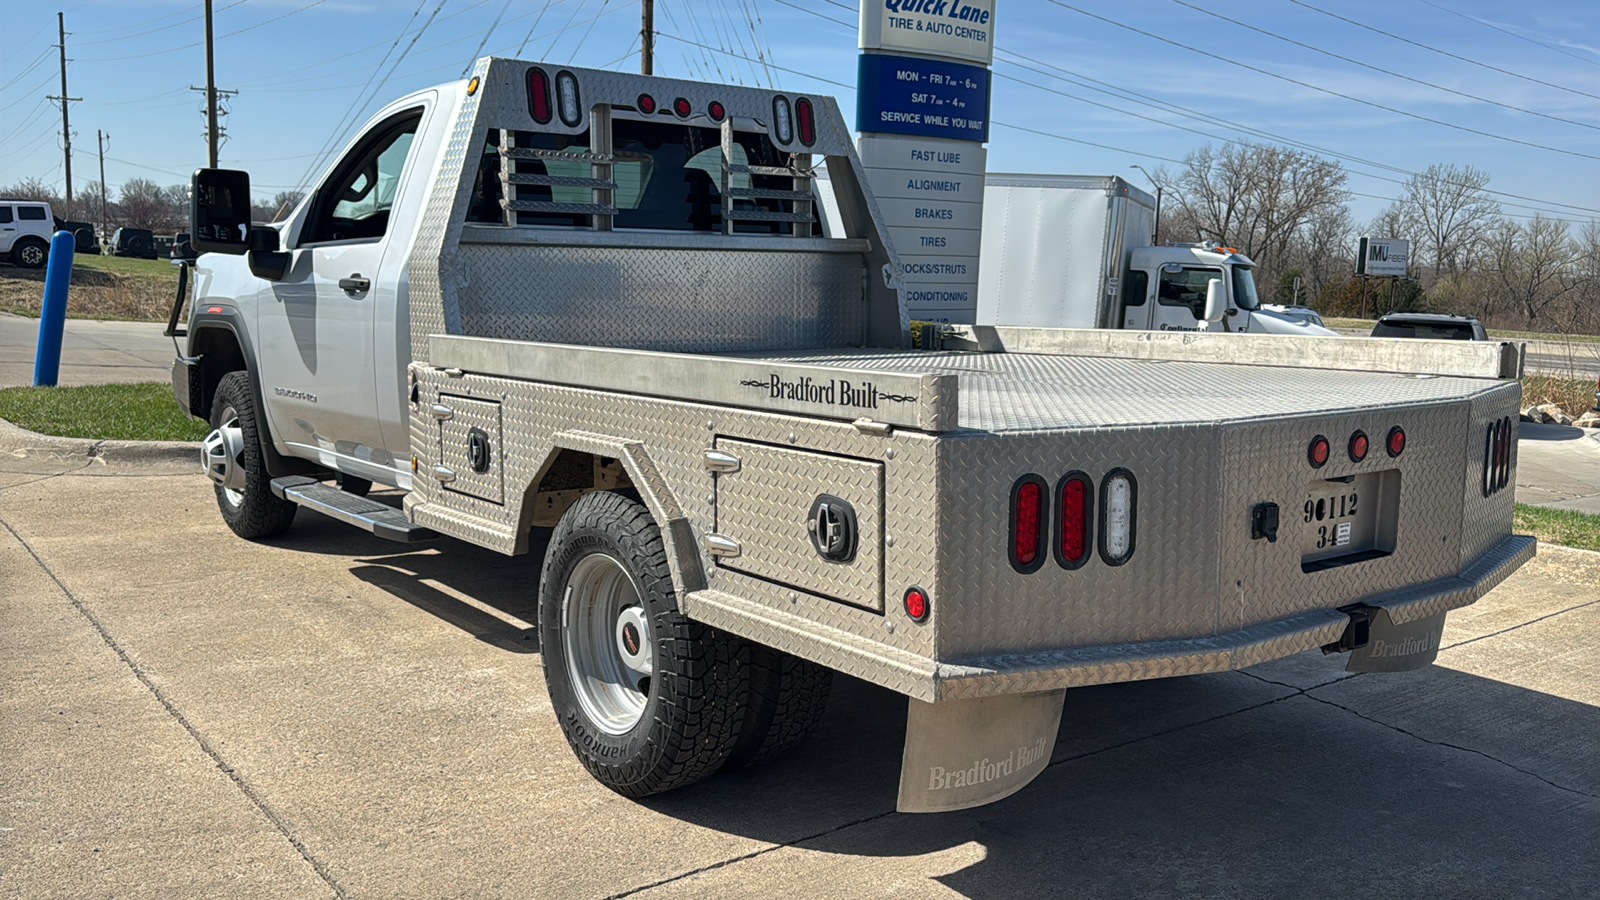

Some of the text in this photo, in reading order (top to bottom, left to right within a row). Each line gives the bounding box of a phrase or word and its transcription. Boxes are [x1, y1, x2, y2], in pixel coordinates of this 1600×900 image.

[947, 0, 989, 24] Lane
[888, 16, 987, 42] TIRE & AUTO CENTER
[896, 70, 919, 82] MON
[930, 74, 942, 85] FRI
[911, 92, 928, 104] SAT
[880, 110, 983, 130] SERVICE WHILE YOU WAIT
[910, 149, 961, 164] FAST LUBE
[906, 179, 962, 193] ALIGNMENT
[914, 208, 954, 220] BRAKES
[920, 236, 946, 248] TIRES
[902, 263, 967, 275] OCKS/STRUTS
[906, 291, 968, 302] CONDITIONING
[770, 374, 878, 409] Bradford Built
[1370, 631, 1429, 658] Bradford
[926, 737, 1047, 791] Bradford Built
